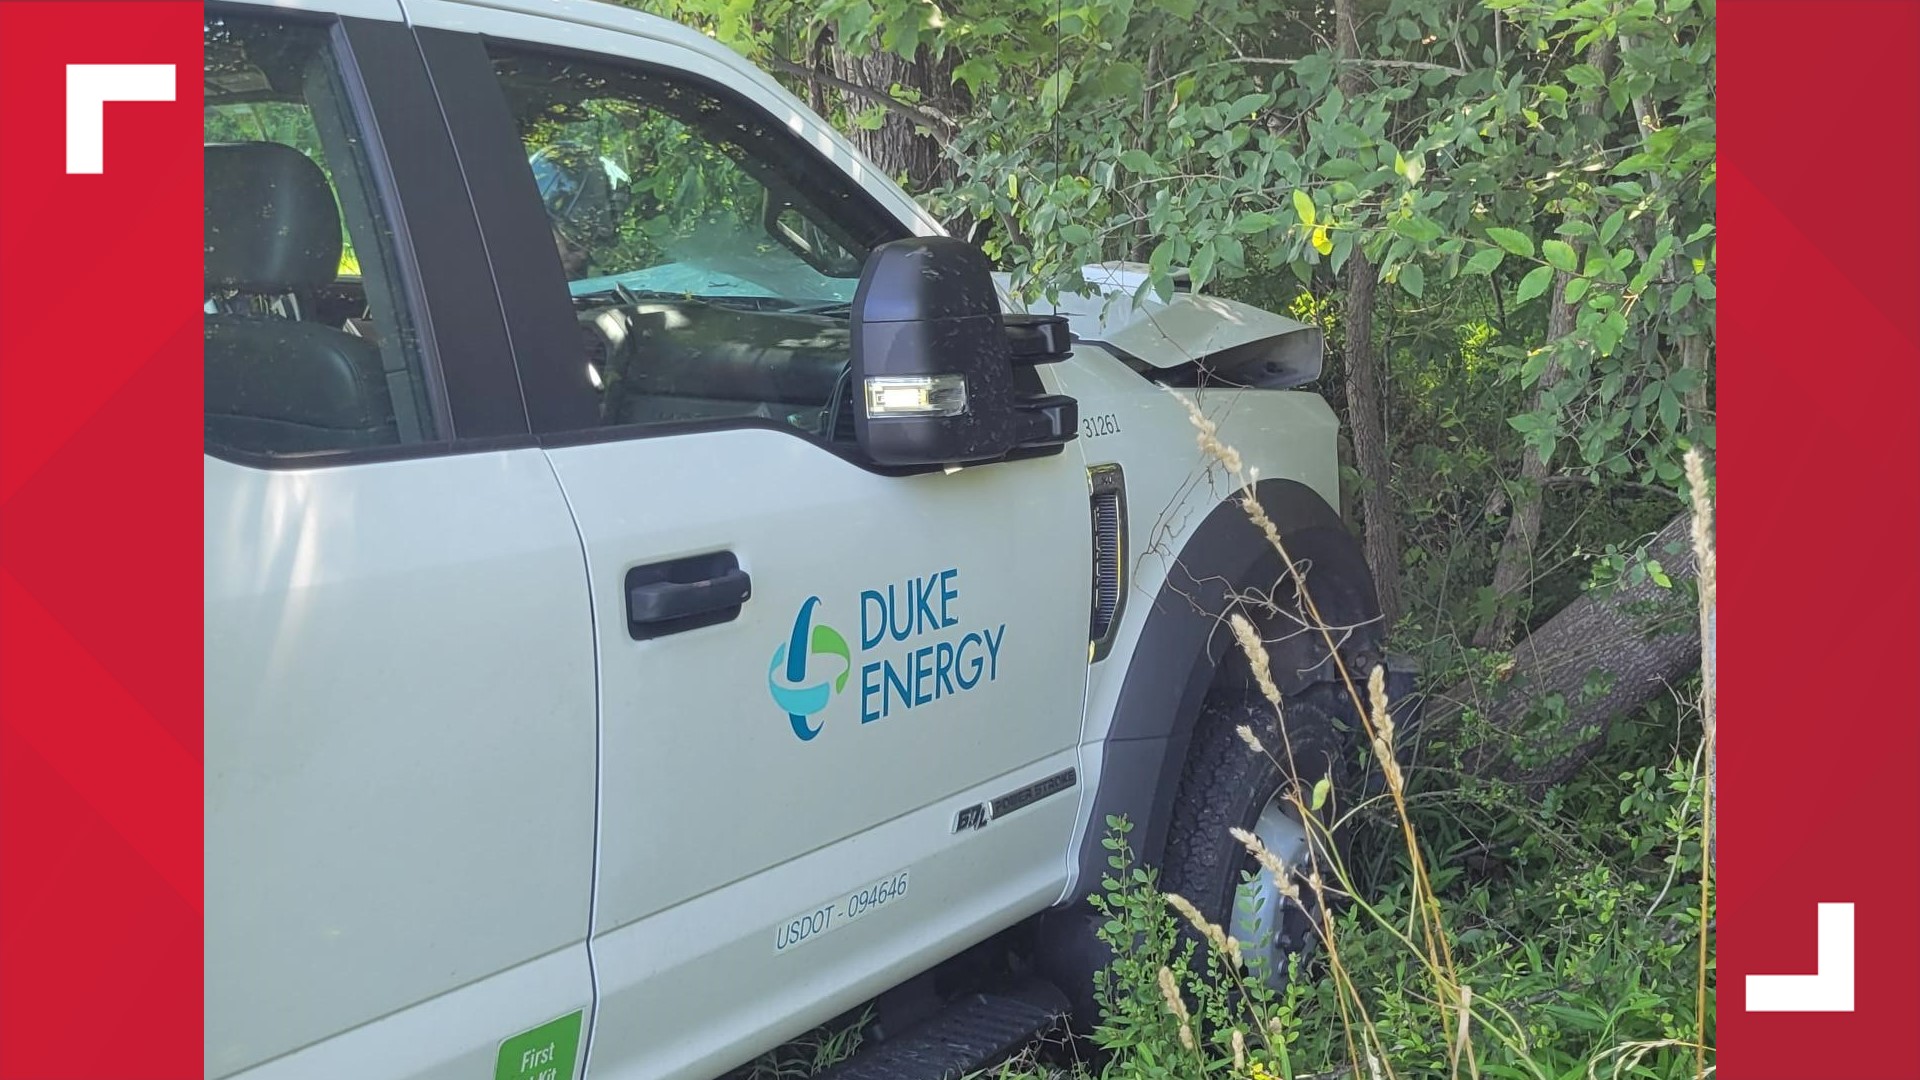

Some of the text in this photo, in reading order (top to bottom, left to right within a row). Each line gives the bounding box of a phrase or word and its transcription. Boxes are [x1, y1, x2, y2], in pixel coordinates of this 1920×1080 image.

[1083, 413, 1121, 438] 31261
[860, 568, 958, 651] DUKE
[861, 623, 1006, 725] ENERGY
[776, 904, 835, 950] USDOT
[848, 872, 908, 918] 094646
[520, 1041, 556, 1073] First
